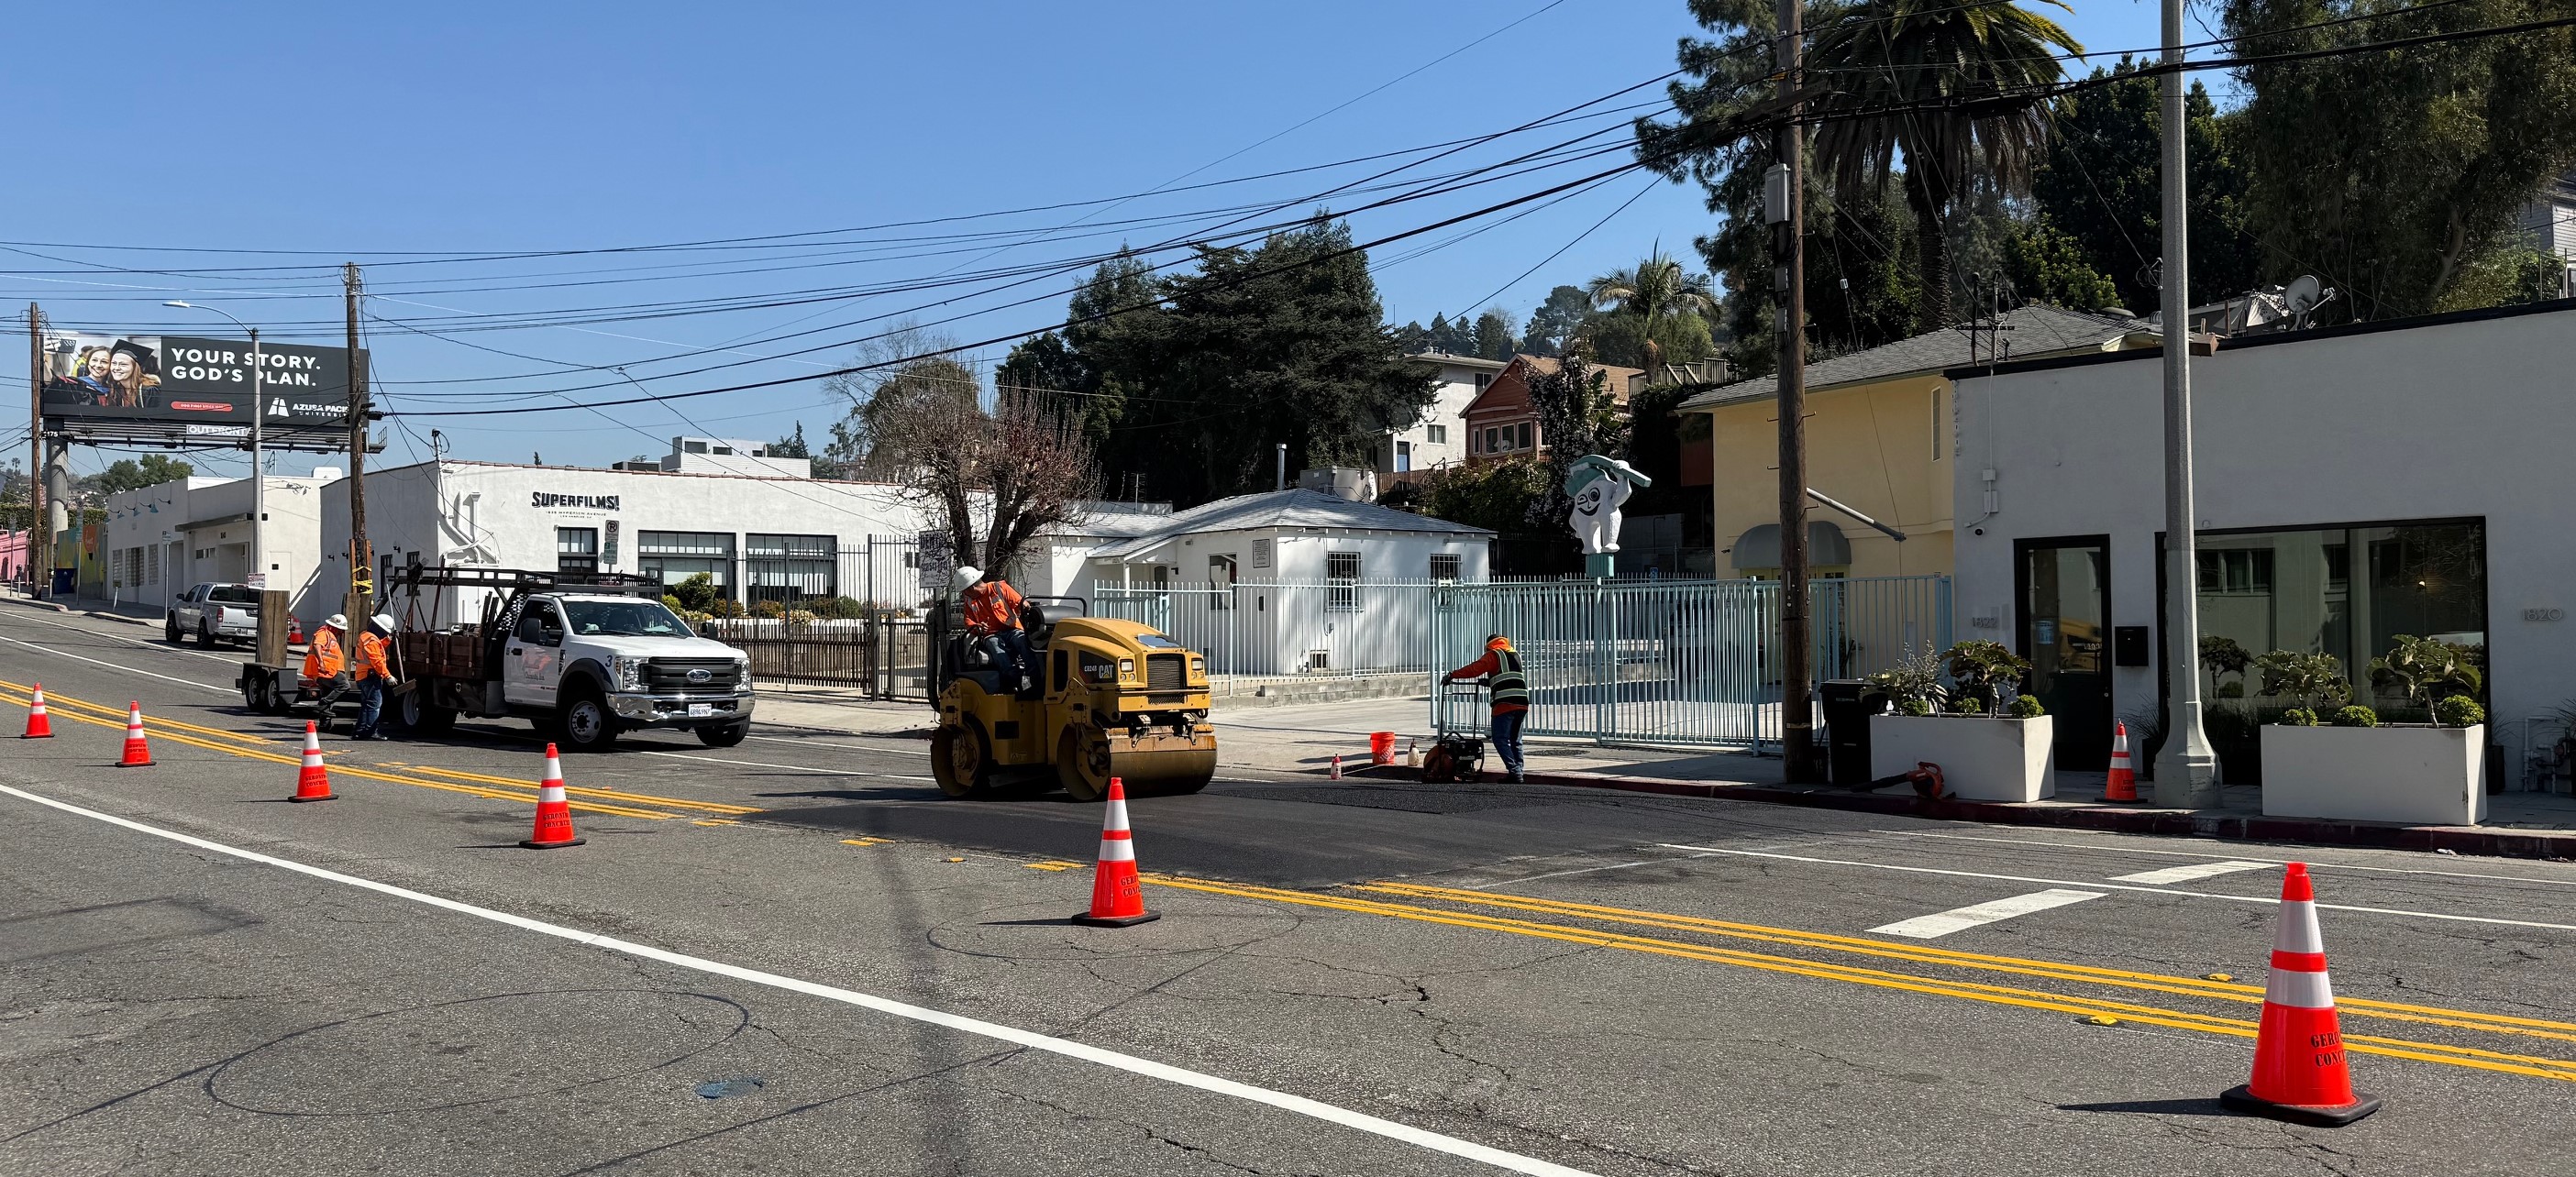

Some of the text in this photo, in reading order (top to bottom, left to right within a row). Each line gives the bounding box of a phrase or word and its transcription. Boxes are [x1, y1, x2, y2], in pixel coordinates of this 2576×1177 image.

[171, 347, 321, 370] YOUR STORY.
[171, 366, 243, 382] GOD'S
[532, 492, 619, 512] SUPERFILMS!
[2523, 608, 2562, 621] 1820
[1972, 616, 1997, 629] 1822
[605, 654, 614, 667] 3
[1099, 665, 1114, 679] CAT
[2311, 1031, 2340, 1047] GERO
